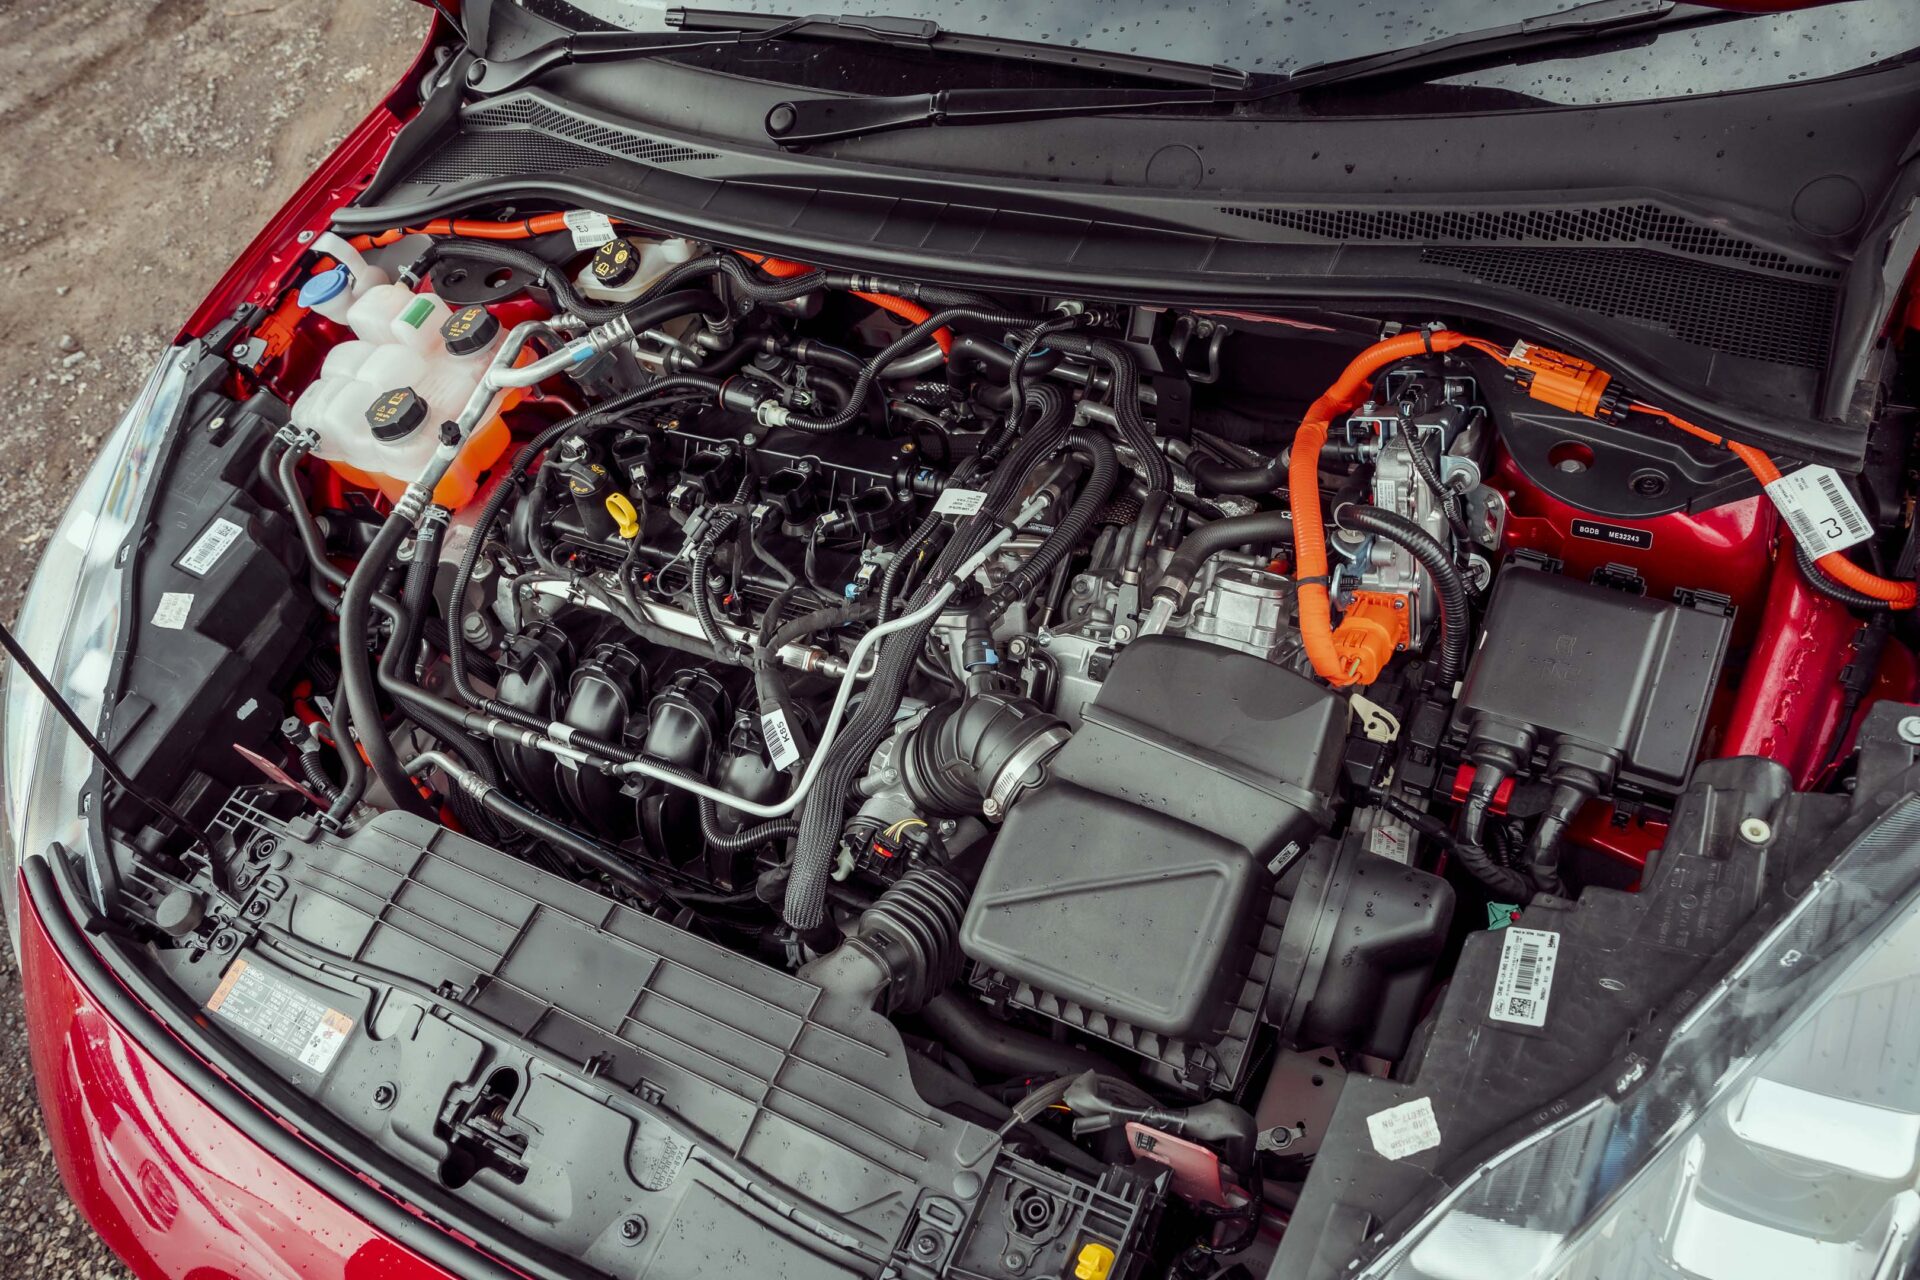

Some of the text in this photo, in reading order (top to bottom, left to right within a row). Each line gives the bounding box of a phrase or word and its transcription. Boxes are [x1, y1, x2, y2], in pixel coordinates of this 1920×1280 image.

[1608, 530, 1640, 543] ME32243
[1820, 517, 1843, 539] CJ
[776, 721, 790, 743] K85
